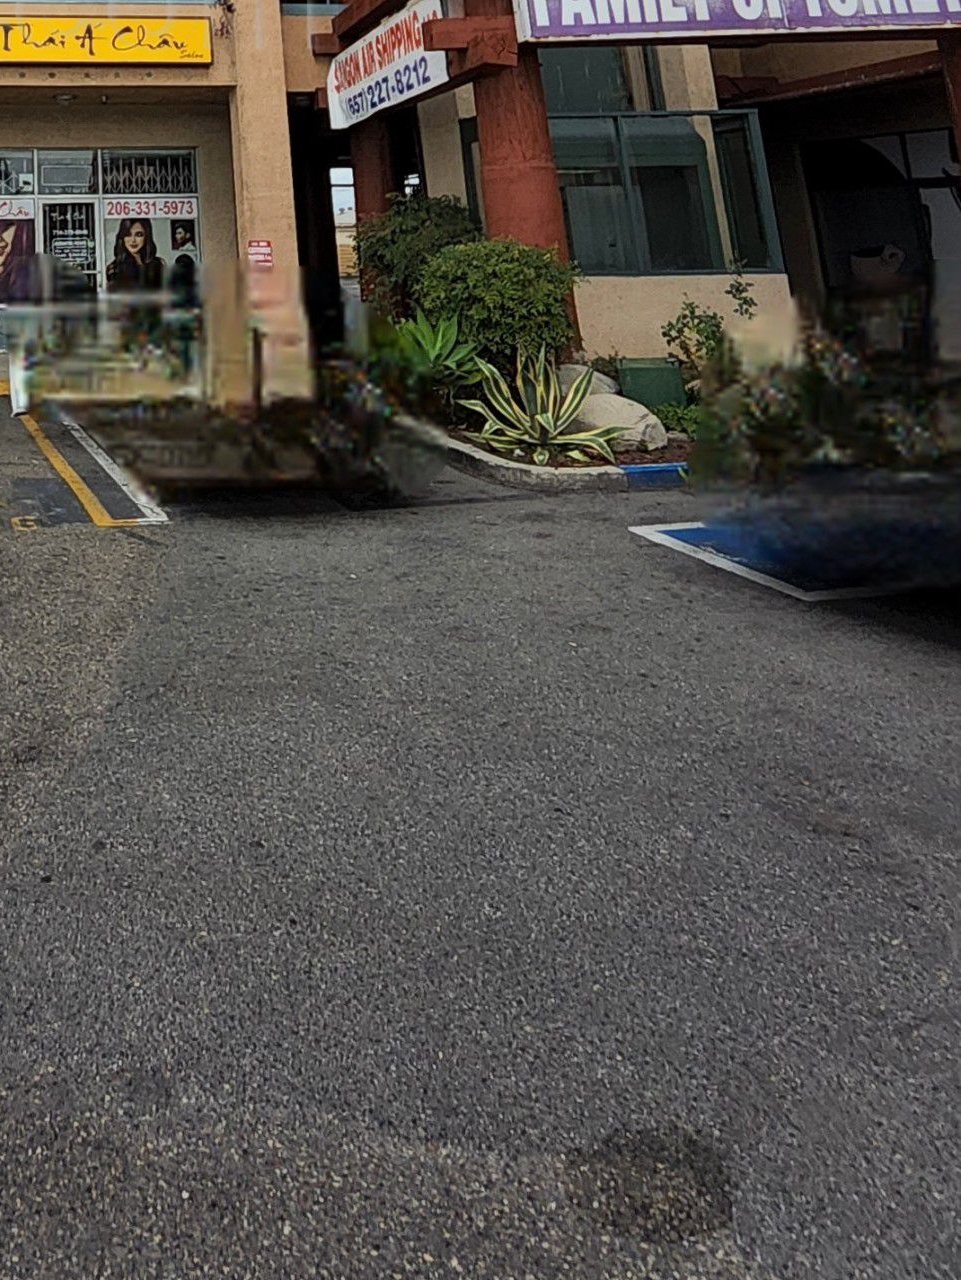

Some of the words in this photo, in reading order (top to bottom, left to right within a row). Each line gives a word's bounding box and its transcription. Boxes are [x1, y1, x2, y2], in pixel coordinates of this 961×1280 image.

[361, 40, 378, 79] AIR
[375, 9, 422, 71] SHIPPING
[345, 87, 369, 120] (657)
[366, 55, 432, 109] 227-8212
[106, 200, 194, 216] 206-331-5973
